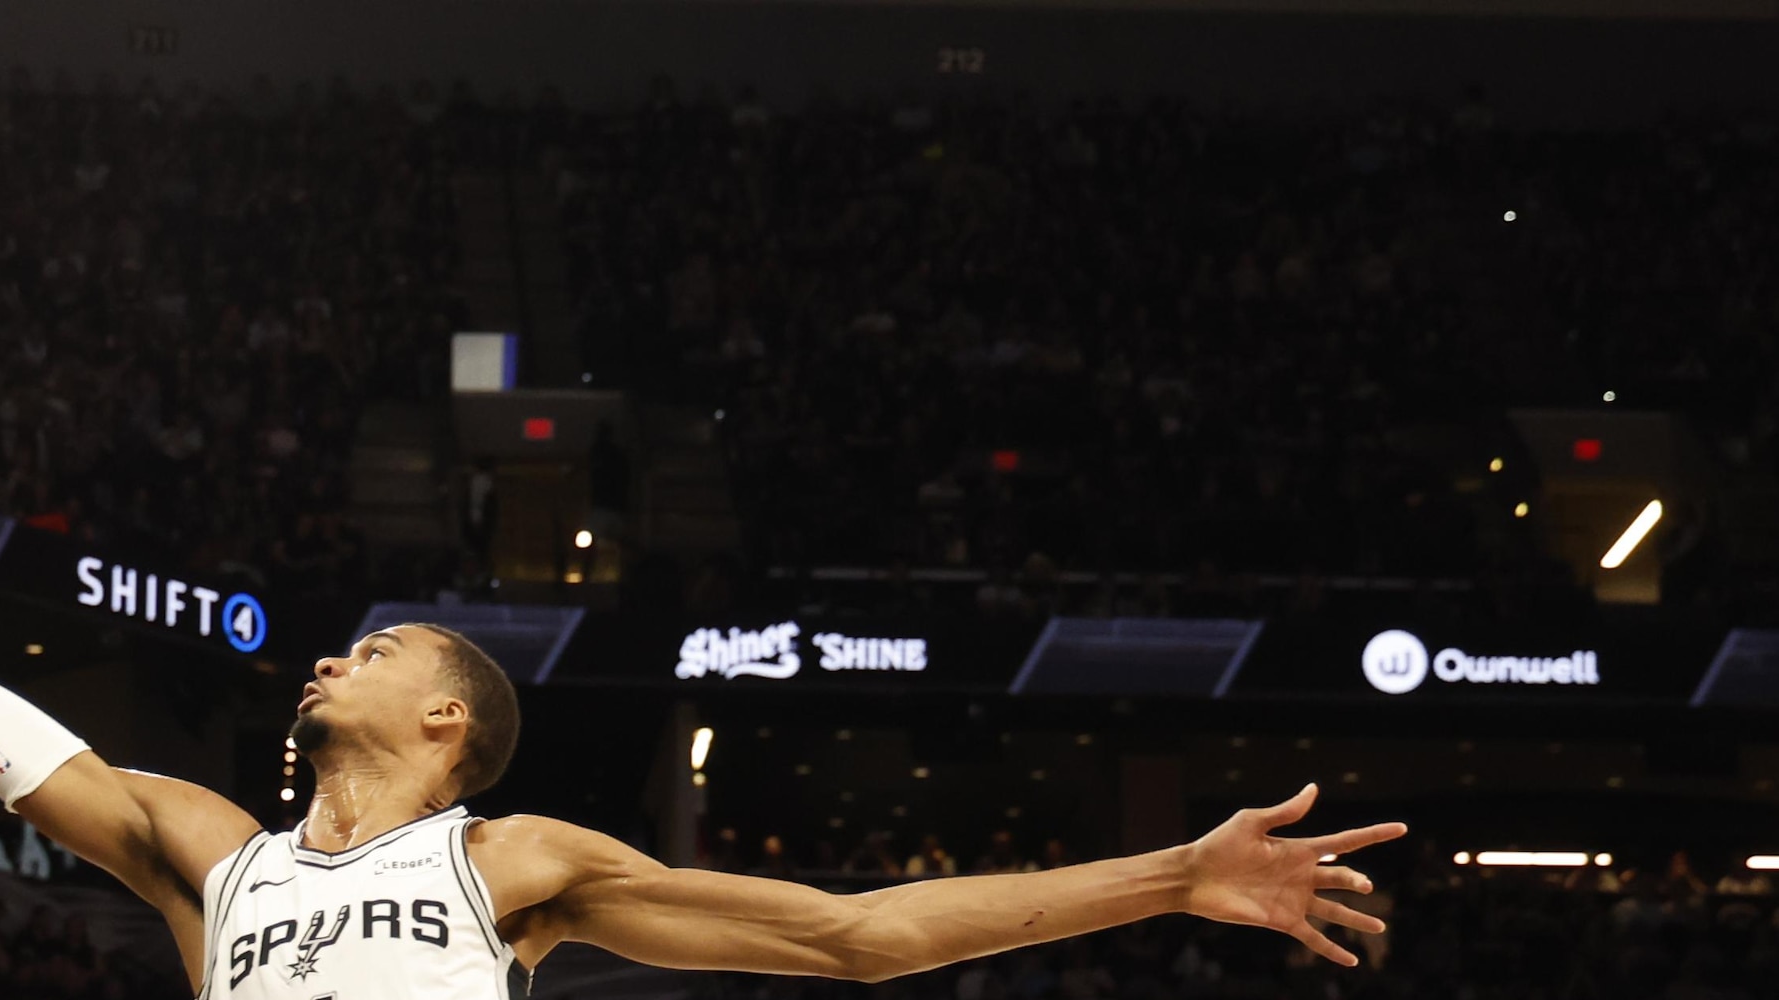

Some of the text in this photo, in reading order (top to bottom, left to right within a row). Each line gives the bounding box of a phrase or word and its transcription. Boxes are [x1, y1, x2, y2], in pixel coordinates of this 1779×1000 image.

[674, 620, 802, 680] Shiner
[1432, 647, 1600, 685] Ownwell
[382, 857, 433, 869] LEDGER
[230, 898, 449, 992] SPURS
